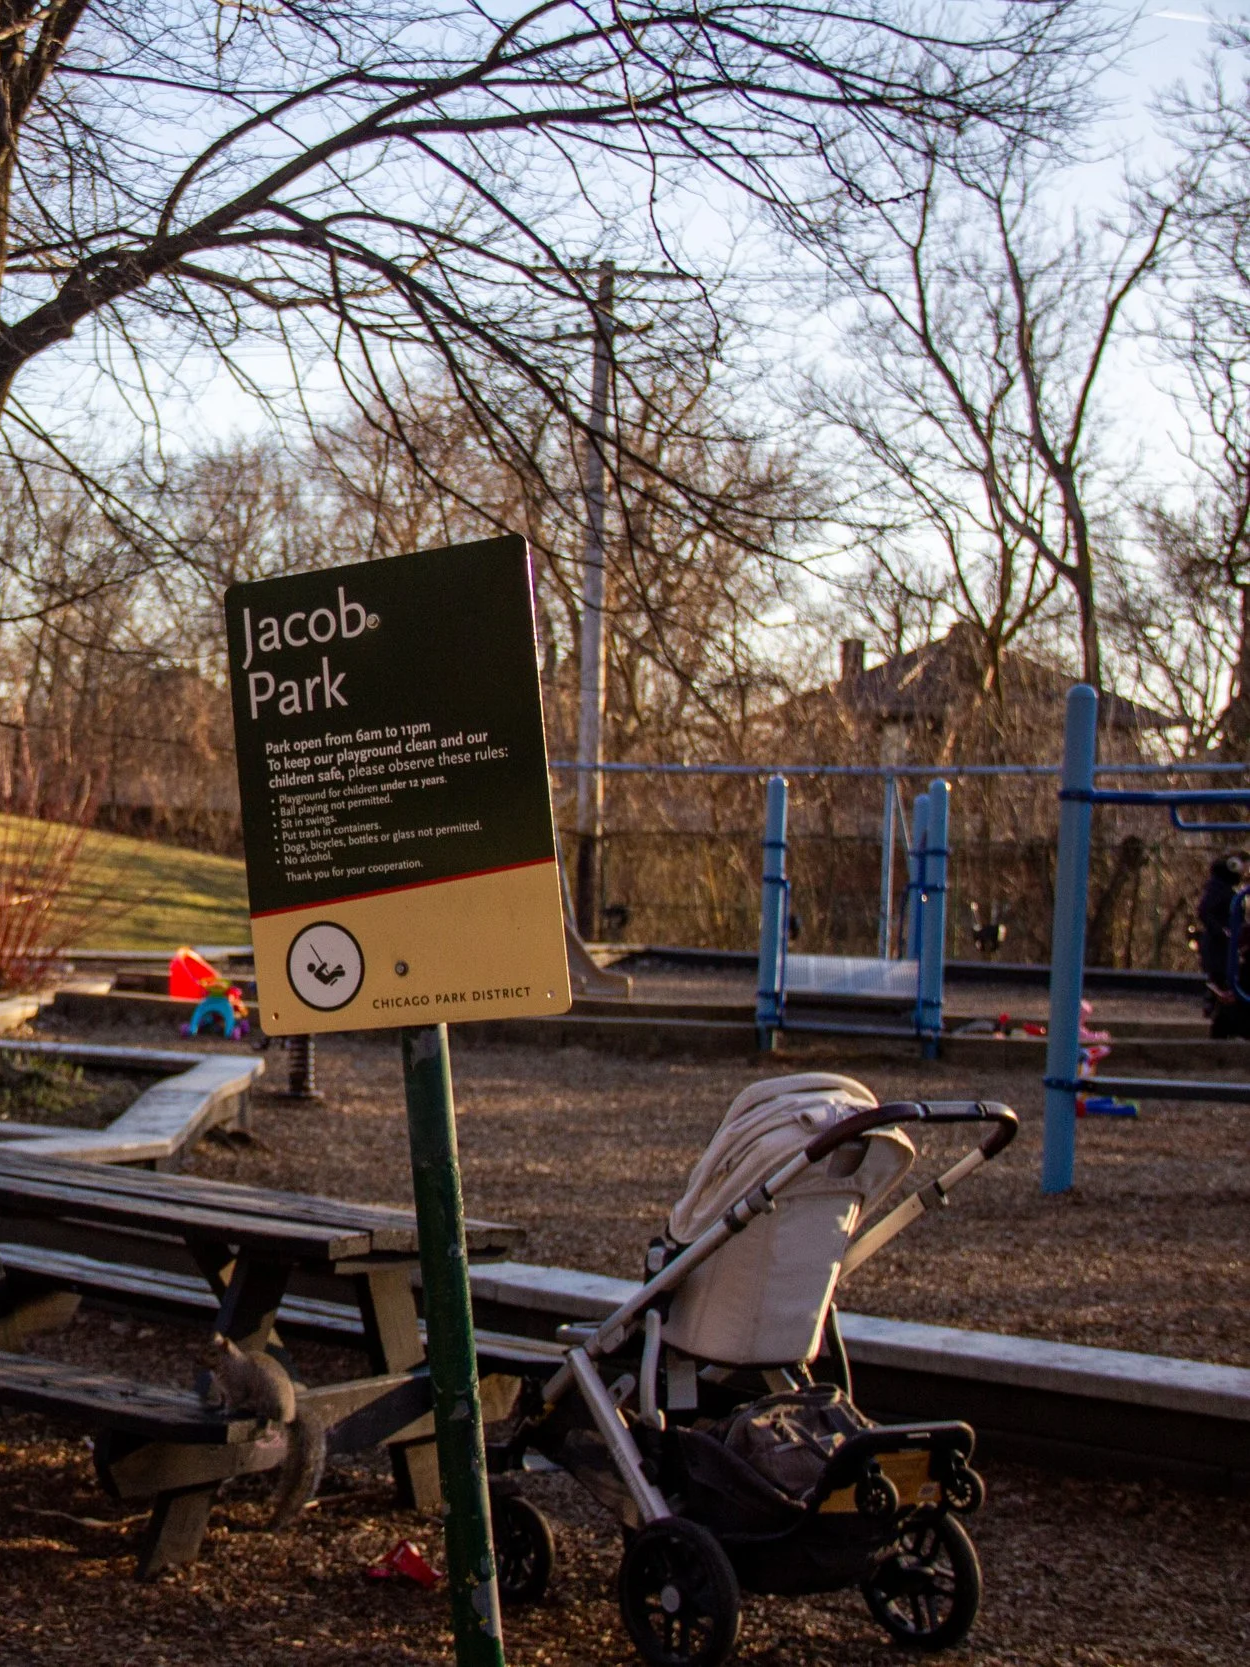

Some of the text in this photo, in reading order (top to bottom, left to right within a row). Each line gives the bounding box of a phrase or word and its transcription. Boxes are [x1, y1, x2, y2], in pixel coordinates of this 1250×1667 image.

[242, 586, 367, 670] Jacob
[248, 657, 349, 719] Park
[266, 722, 431, 755] Park open from 6am to 11pm
[267, 732, 489, 772] To keep our playground clean and our
[268, 746, 508, 789] children safe, please observe these rules:
[279, 775, 447, 805] Playground for children under 12 years.
[280, 794, 393, 817] Ball playing not permitted.
[281, 815, 338, 829] Sit in swings.
[282, 822, 382, 841] Put trash in containers.
[283, 820, 483, 854] Dogs, bicycles, bottles or glass not permitted.
[284, 850, 334, 866] No alcohol.
[286, 858, 424, 882] Thank you for your cooperation.
[372, 987, 531, 1010] CHICAGO PARK DISTRICT
